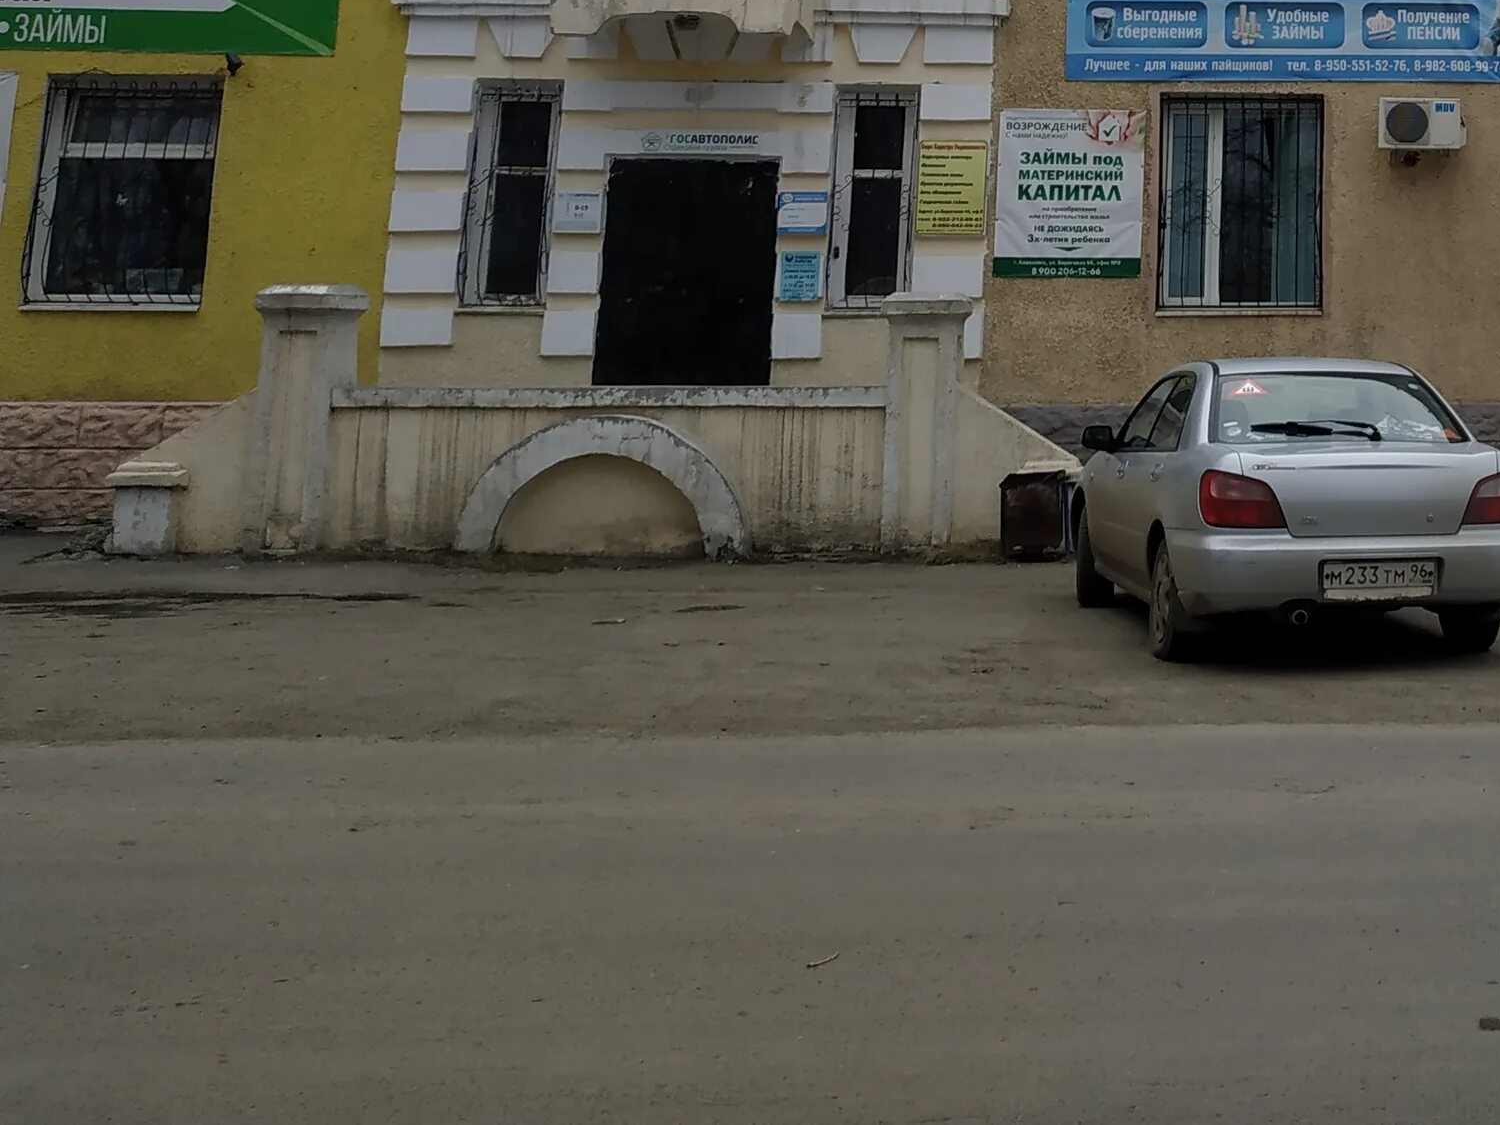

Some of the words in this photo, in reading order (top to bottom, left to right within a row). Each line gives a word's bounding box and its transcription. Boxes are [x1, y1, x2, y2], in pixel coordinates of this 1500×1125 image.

[1122, 7, 1197, 23] Выгодные
[1266, 8, 1329, 24] Удобные
[1397, 9, 1470, 25] Получение
[14, 7, 106, 44] ЗАЙМЫ
[1117, 25, 1203, 41] сбережения
[1272, 24, 1324, 41] ЗАЙМЫ
[1407, 25, 1461, 41] ПЕНСИИ
[1084, 58, 1131, 72] Лучшее
[1144, 59, 1166, 72] для
[1170, 59, 1208, 72] наших
[1211, 58, 1273, 73] пайщиков!
[1287, 59, 1310, 73] тел.
[1314, 59, 1410, 74] 8-950-551-52-76,
[1006, 121, 1088, 133] ВОЗРОЖДЕНИЕ
[669, 133, 759, 145] ГОСАВТОПОЛИС
[1019, 148, 1088, 166] ЗАЙМЫ
[1092, 155, 1124, 168] под
[1018, 167, 1124, 182] МАТЕРИНСКИЙ
[1017, 183, 1122, 202] КАПИТАЛ
[1041, 213, 1089, 221] строительство
[1051, 205, 1097, 213] приобретение
[1034, 225, 1045, 233] НЕ
[1046, 224, 1104, 234] ДОЖИДАЯСЬ
[1027, 234, 1069, 244] 3х-летия
[1071, 234, 1111, 245] ребенка
[1031, 267, 1037, 275] 8
[1038, 267, 1057, 275] 900
[1057, 267, 1102, 276] 206-12-66
[1410, 563, 1429, 578] 96
